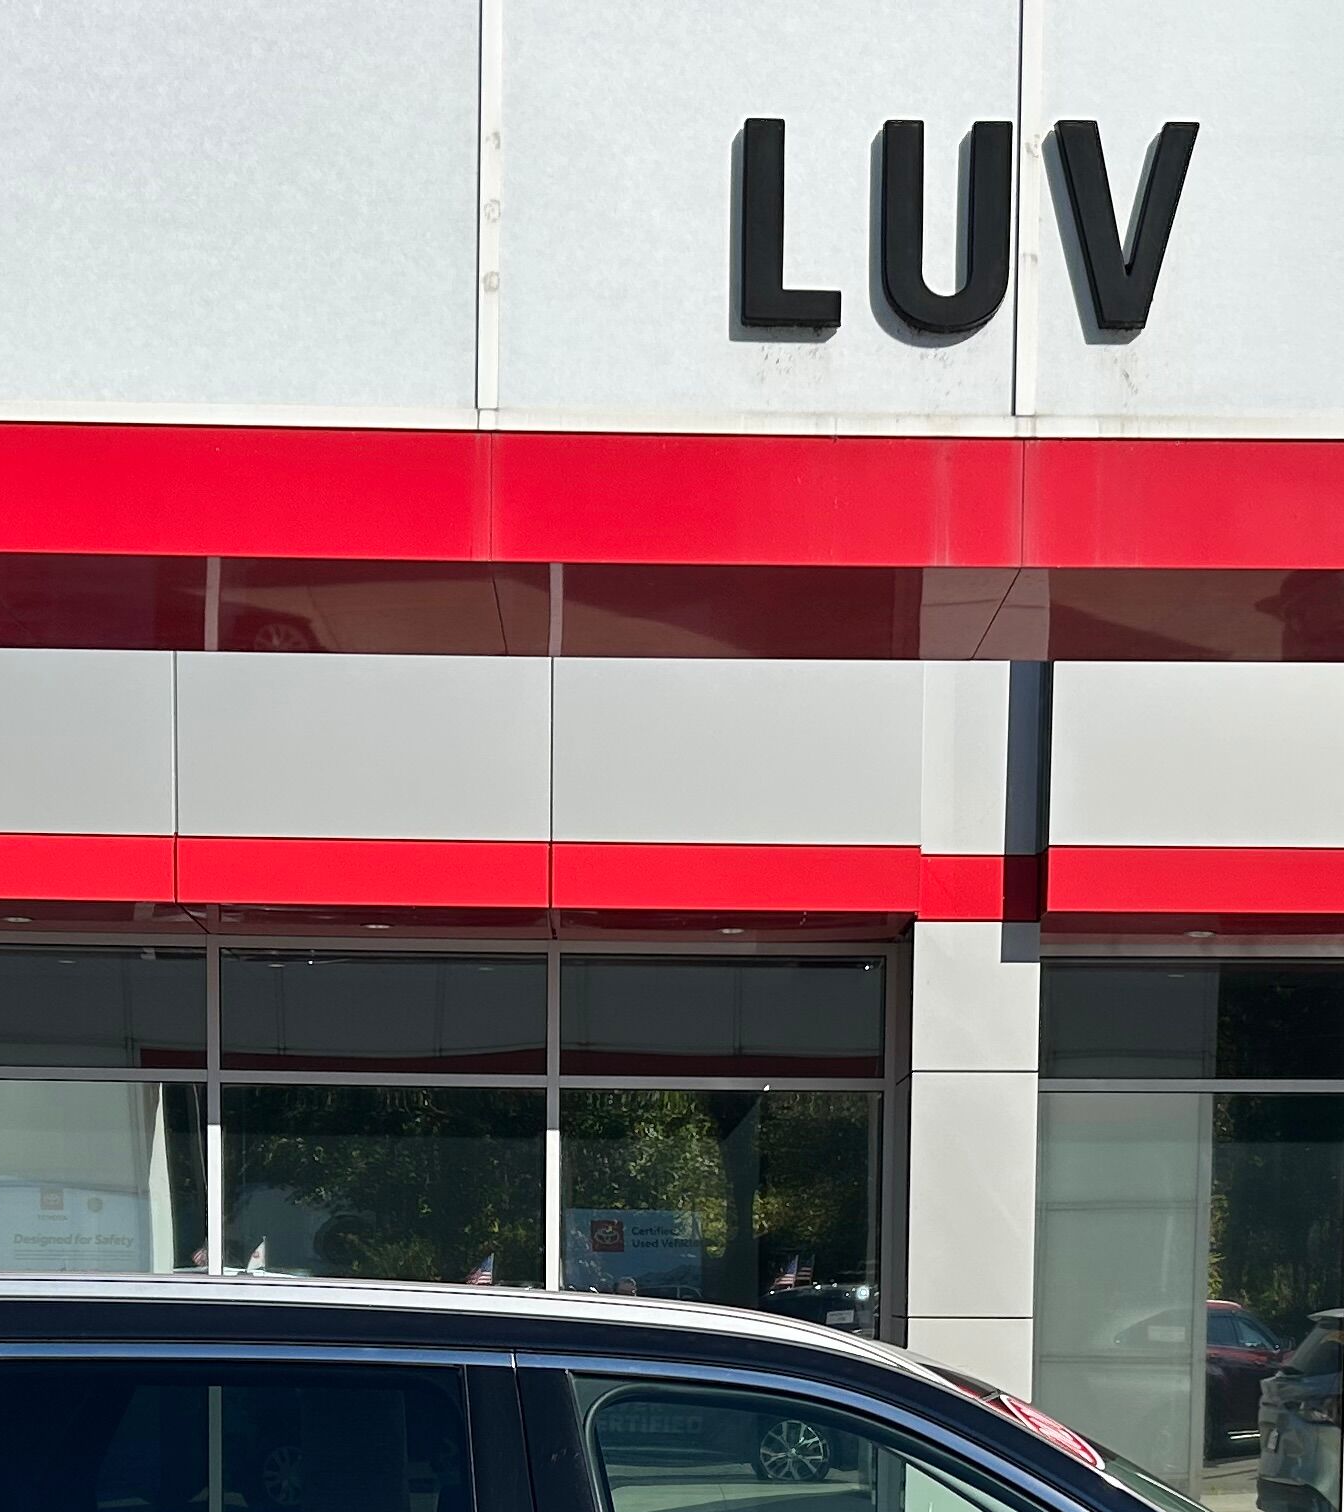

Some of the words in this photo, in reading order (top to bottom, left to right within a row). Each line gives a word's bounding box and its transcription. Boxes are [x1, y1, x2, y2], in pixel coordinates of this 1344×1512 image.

[741, 117, 1201, 333] LUV
[14, 1233, 73, 1247] Designed
[74, 1233, 92, 1245] for
[95, 1234, 134, 1248] Safety
[632, 1239, 658, 1248] Used
[596, 1415, 704, 1433] ERTIFIED
